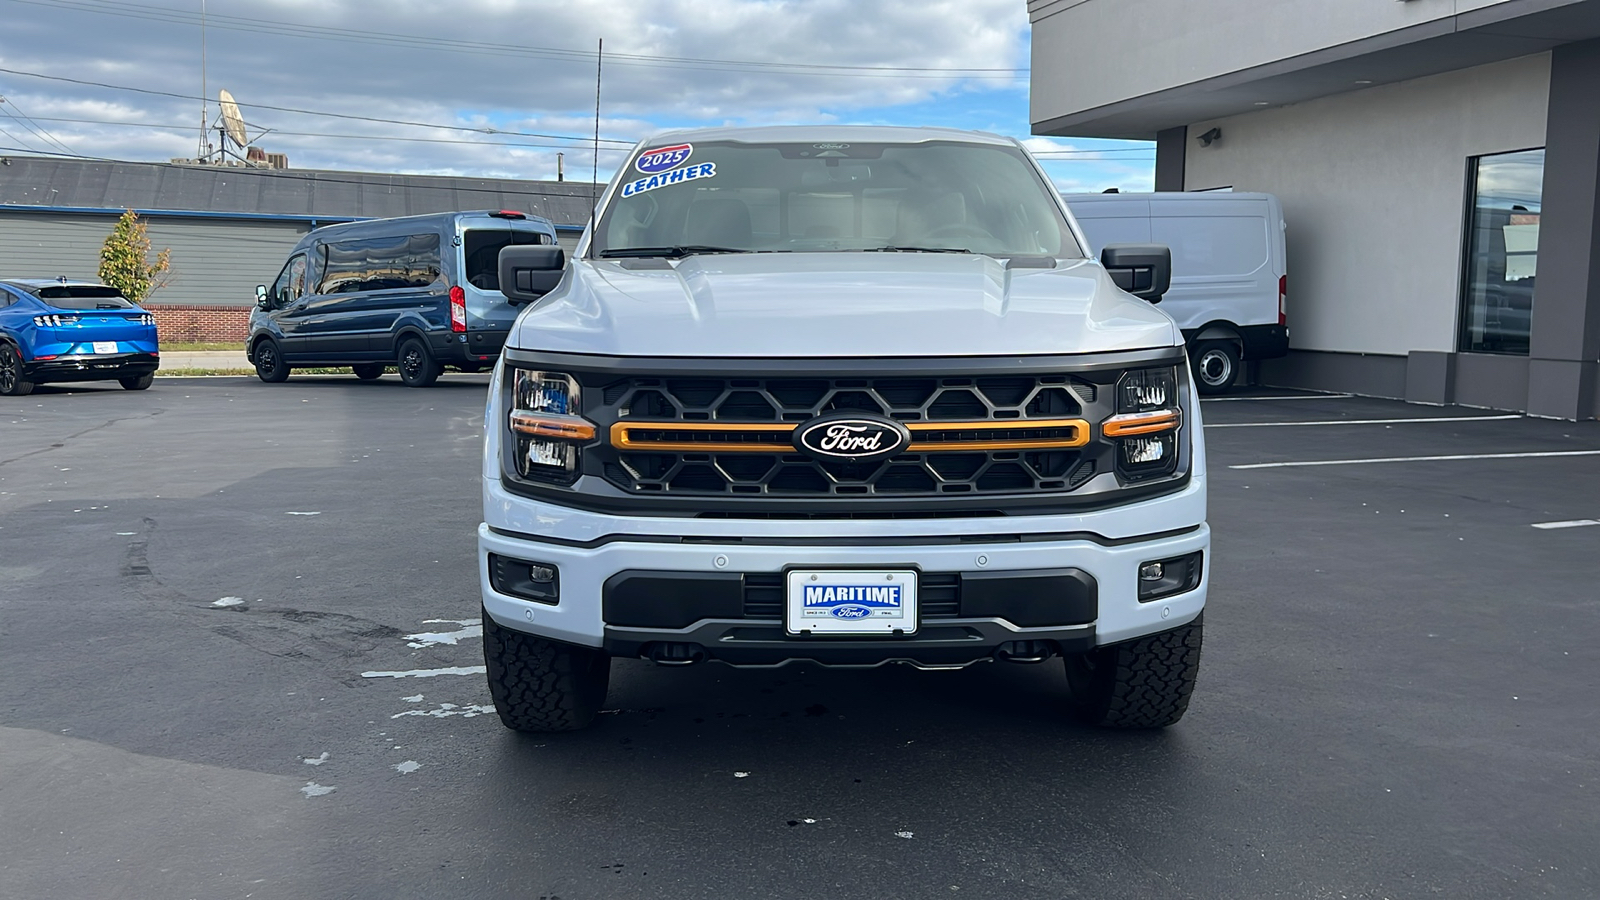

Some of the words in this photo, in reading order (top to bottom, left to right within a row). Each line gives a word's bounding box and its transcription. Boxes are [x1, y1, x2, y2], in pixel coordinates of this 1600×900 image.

[641, 150, 684, 168] 2025
[623, 163, 714, 196] LEATHER
[820, 425, 883, 450] Ford
[806, 587, 899, 606] MARITIME
[837, 606, 865, 617] Ford
